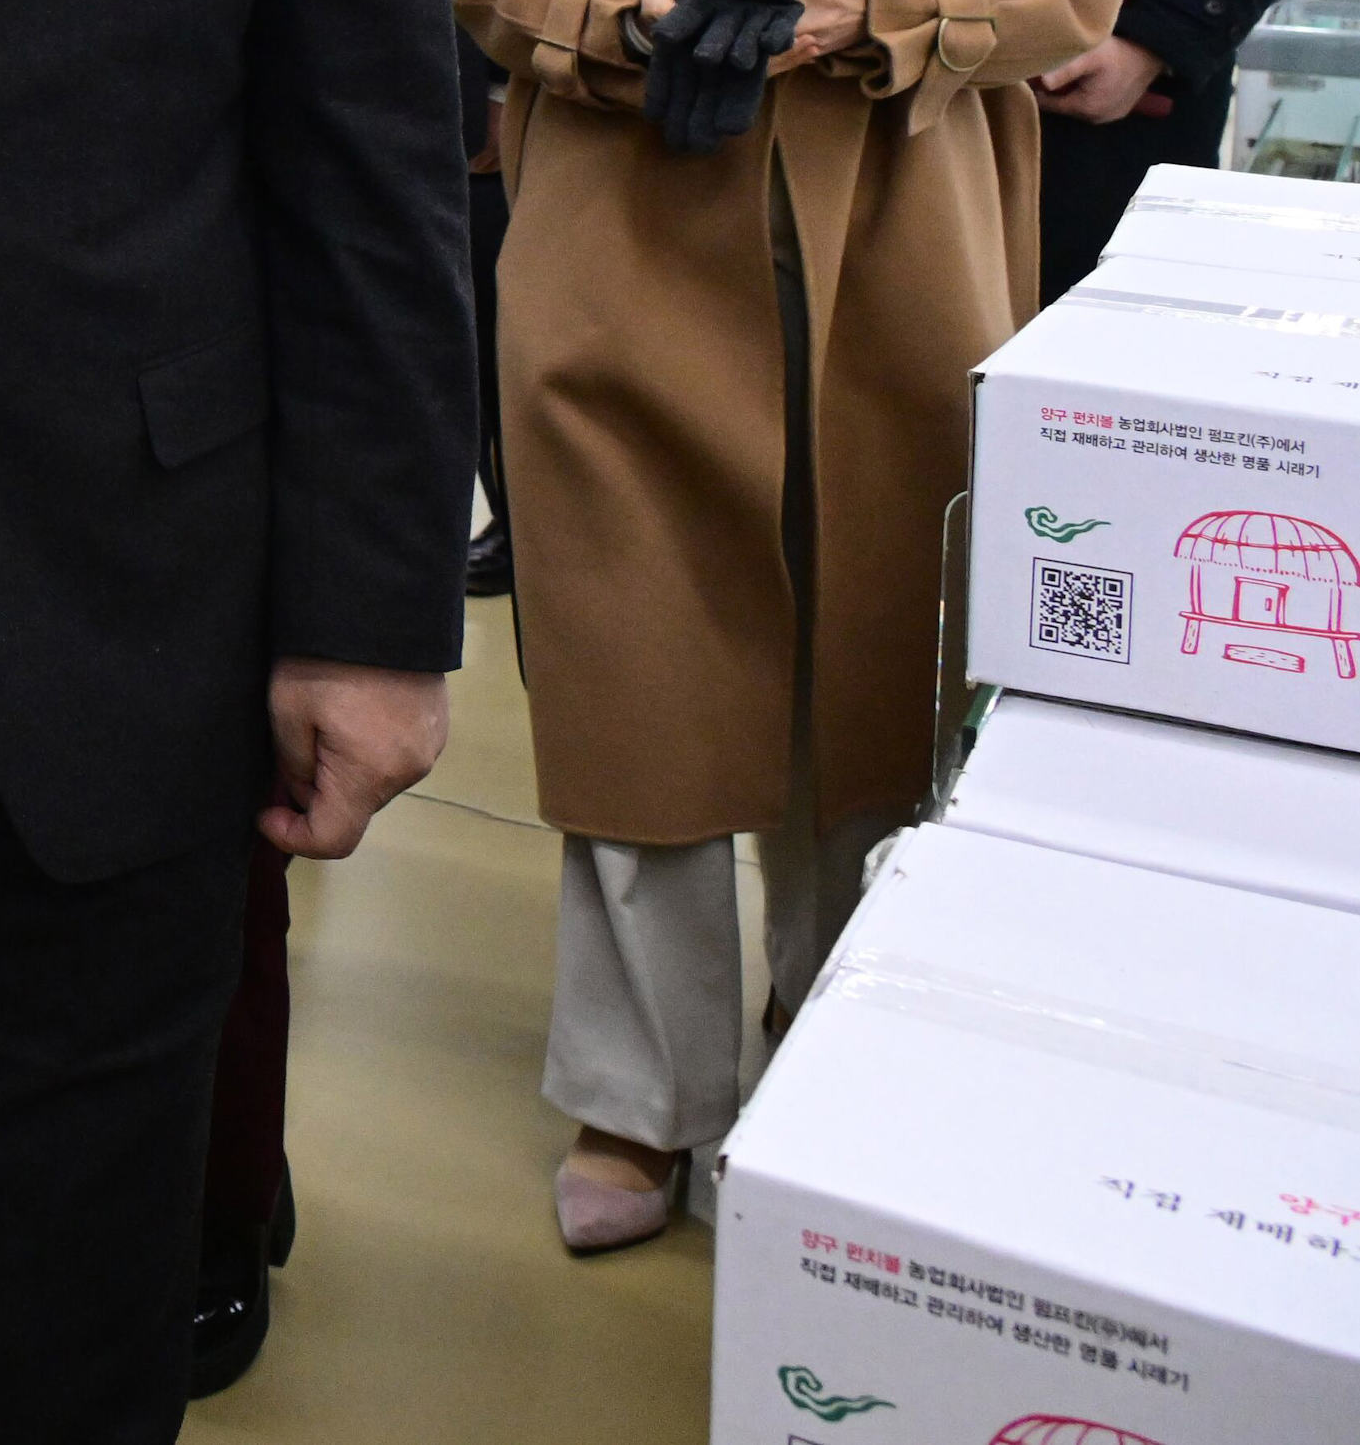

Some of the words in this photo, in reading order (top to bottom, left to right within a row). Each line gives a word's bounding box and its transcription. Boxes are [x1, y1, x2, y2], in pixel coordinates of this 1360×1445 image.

[1039, 427, 1067, 443] 직접
[1071, 431, 1127, 451] 재배하고
[1131, 439, 1188, 460] 관리하여
[1193, 447, 1237, 467] 생산한
[1242, 455, 1271, 472] 명품
[1276, 459, 1320, 479] 시래기
[1040, 407, 1068, 422] 양구
[1072, 411, 1114, 429] 펀치볼
[1118, 416, 1202, 440] 농업회사법인
[1208, 428, 1306, 455] 펌프킨(주)에서
[801, 1227, 839, 1253] 양구
[908, 1258, 1025, 1312] 농업회사법인
[800, 1256, 837, 1285] 직접
[843, 1270, 920, 1308] 재배하고
[926, 1293, 1003, 1336] 관리하여
[1011, 1321, 1071, 1357] 생산한
[1079, 1341, 1119, 1371] 명품
[1126, 1357, 1190, 1394] 시래기
